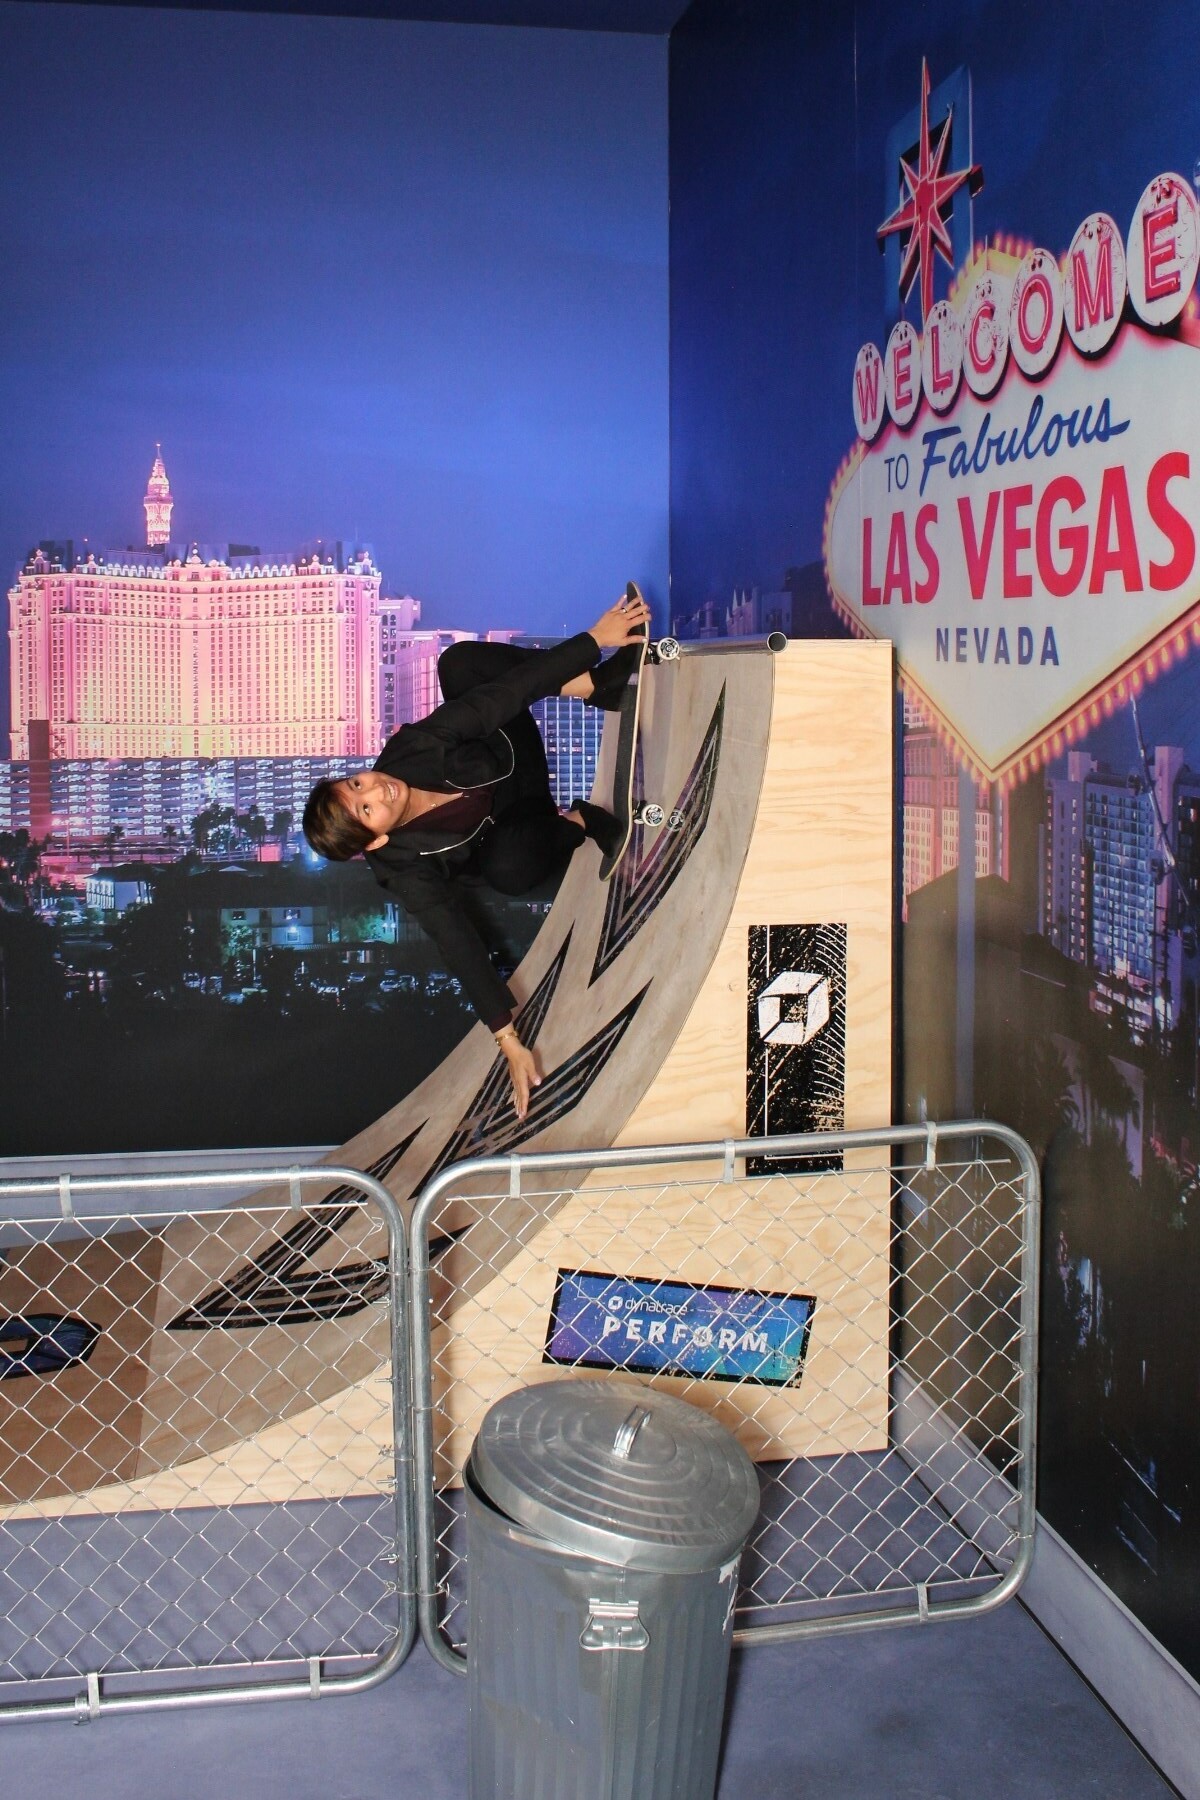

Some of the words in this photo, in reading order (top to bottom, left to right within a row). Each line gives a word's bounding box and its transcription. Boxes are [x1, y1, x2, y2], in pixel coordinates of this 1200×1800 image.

[855, 202, 1181, 425] WELCOME
[884, 455, 909, 492] TO
[919, 394, 1131, 496] Fabulous
[862, 504, 940, 606] LAS
[957, 451, 1197, 600] VEGAS
[935, 626, 1060, 666] NEVADA
[602, 1315, 769, 1353] PERFORM
[625, 1296, 688, 1316] dynatrace
